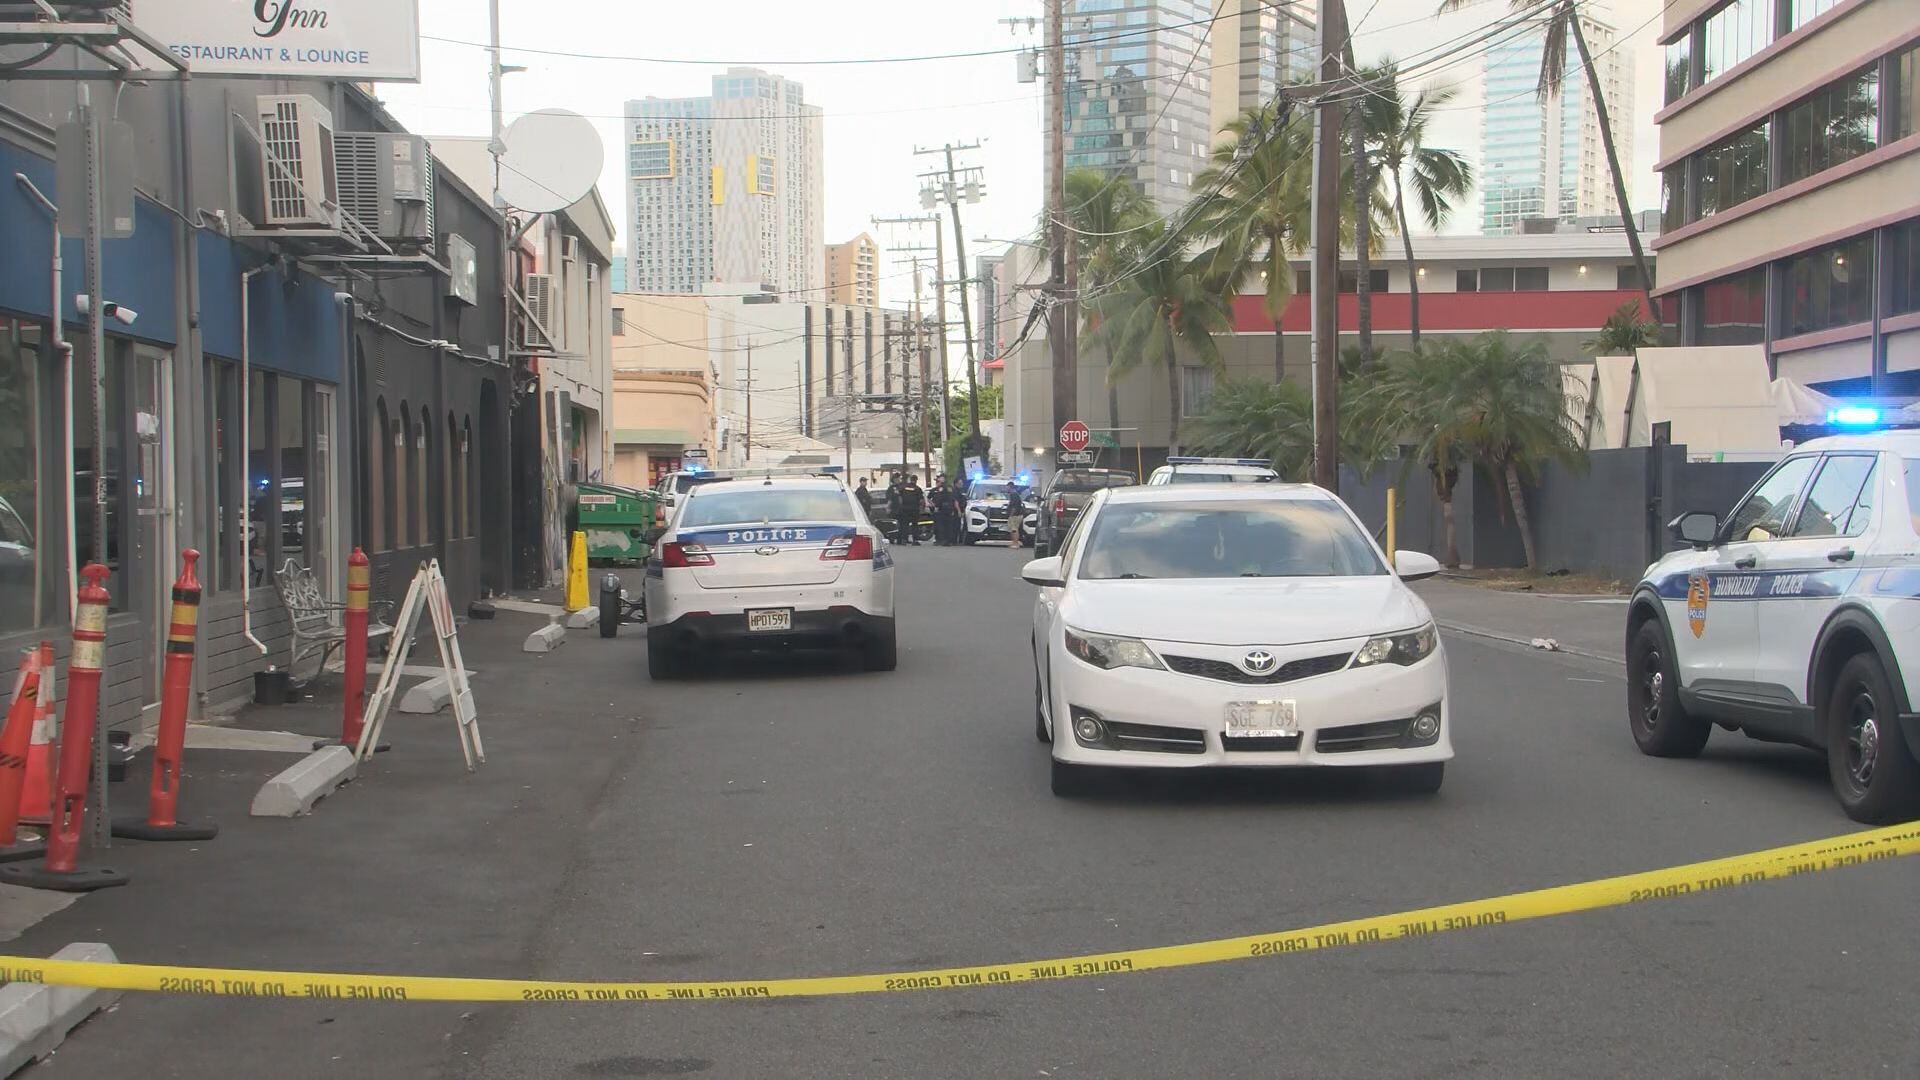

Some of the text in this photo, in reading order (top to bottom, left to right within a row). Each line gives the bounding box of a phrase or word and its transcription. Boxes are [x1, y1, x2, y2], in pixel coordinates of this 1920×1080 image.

[169, 45, 369, 64] ESTAURANT & LOUNGE
[1062, 430, 1088, 442] STOP
[727, 529, 807, 543] POLICE
[1714, 575, 1807, 595] HONOLULU POLICE
[750, 614, 789, 627] HPD1597
